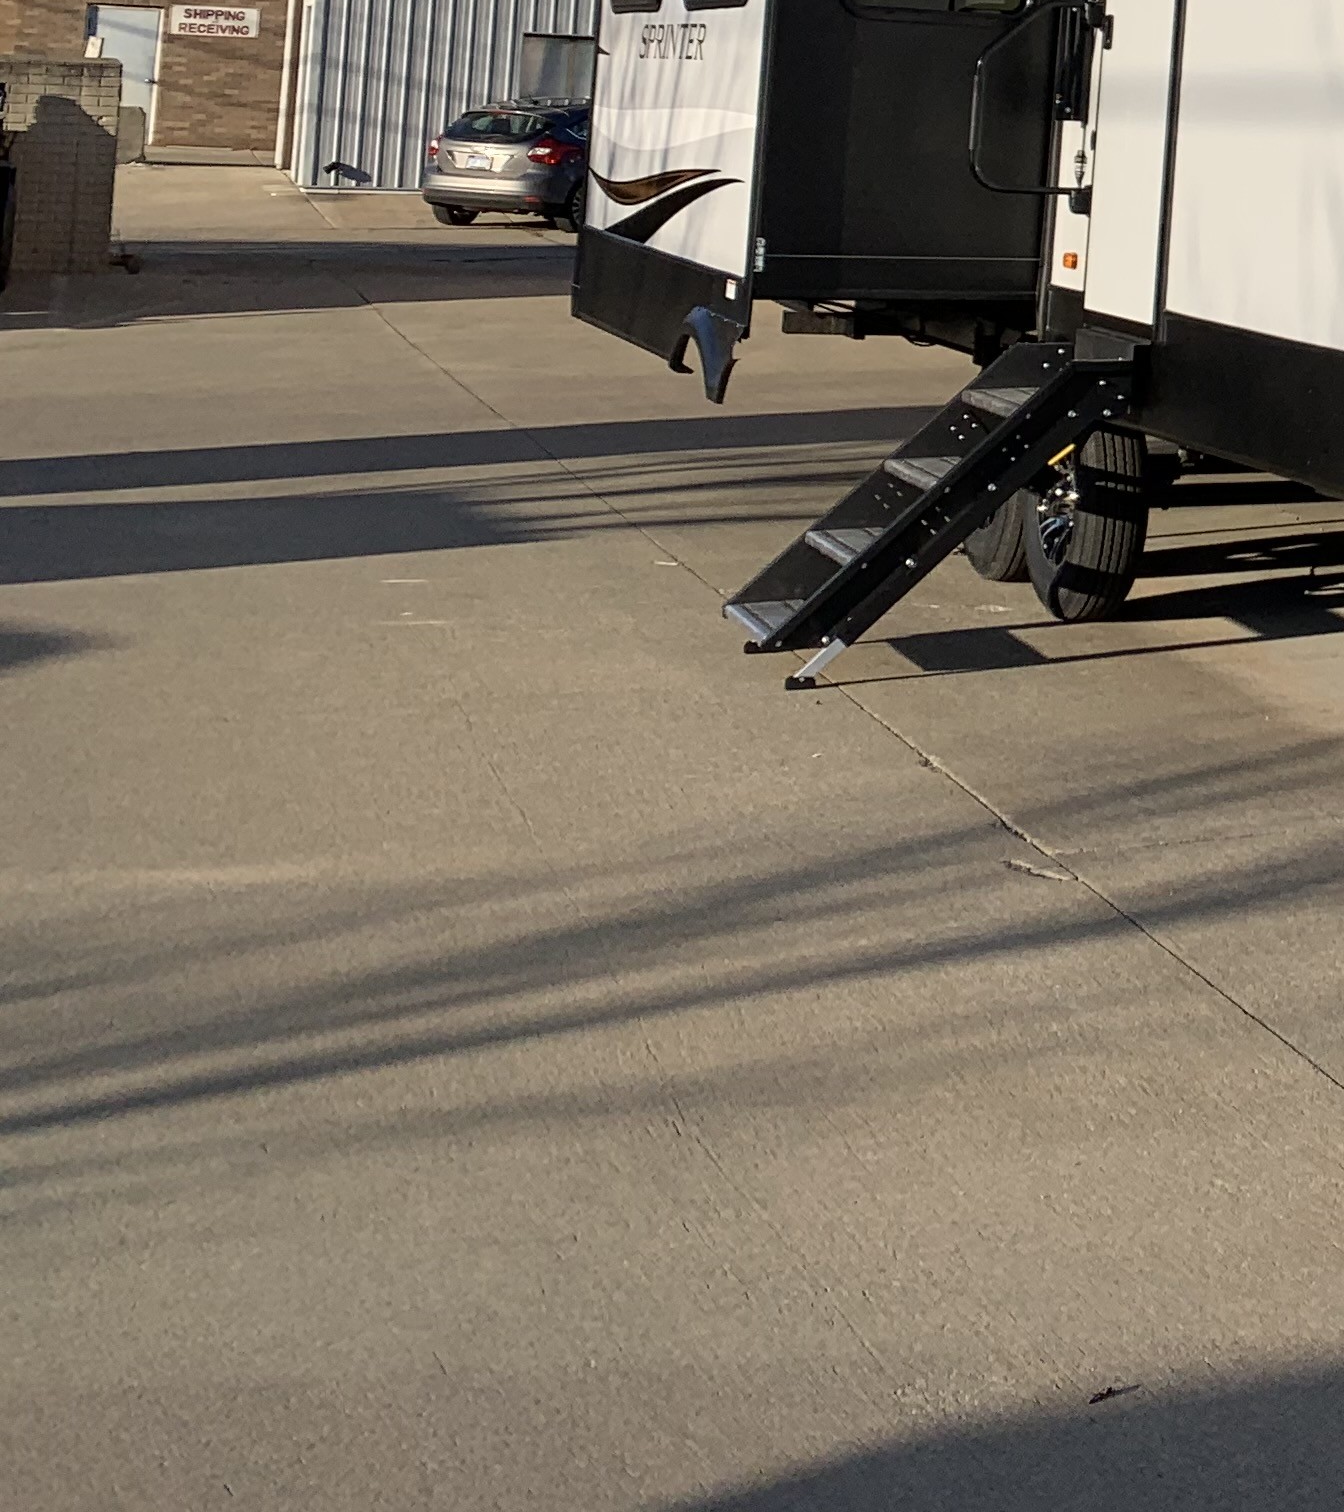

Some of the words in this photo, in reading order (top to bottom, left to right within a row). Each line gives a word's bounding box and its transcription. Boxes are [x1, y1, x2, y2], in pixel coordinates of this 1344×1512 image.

[183, 8, 246, 21] SHIPPING
[178, 22, 250, 36] RECEIVING
[639, 23, 707, 60] SPRINTER
